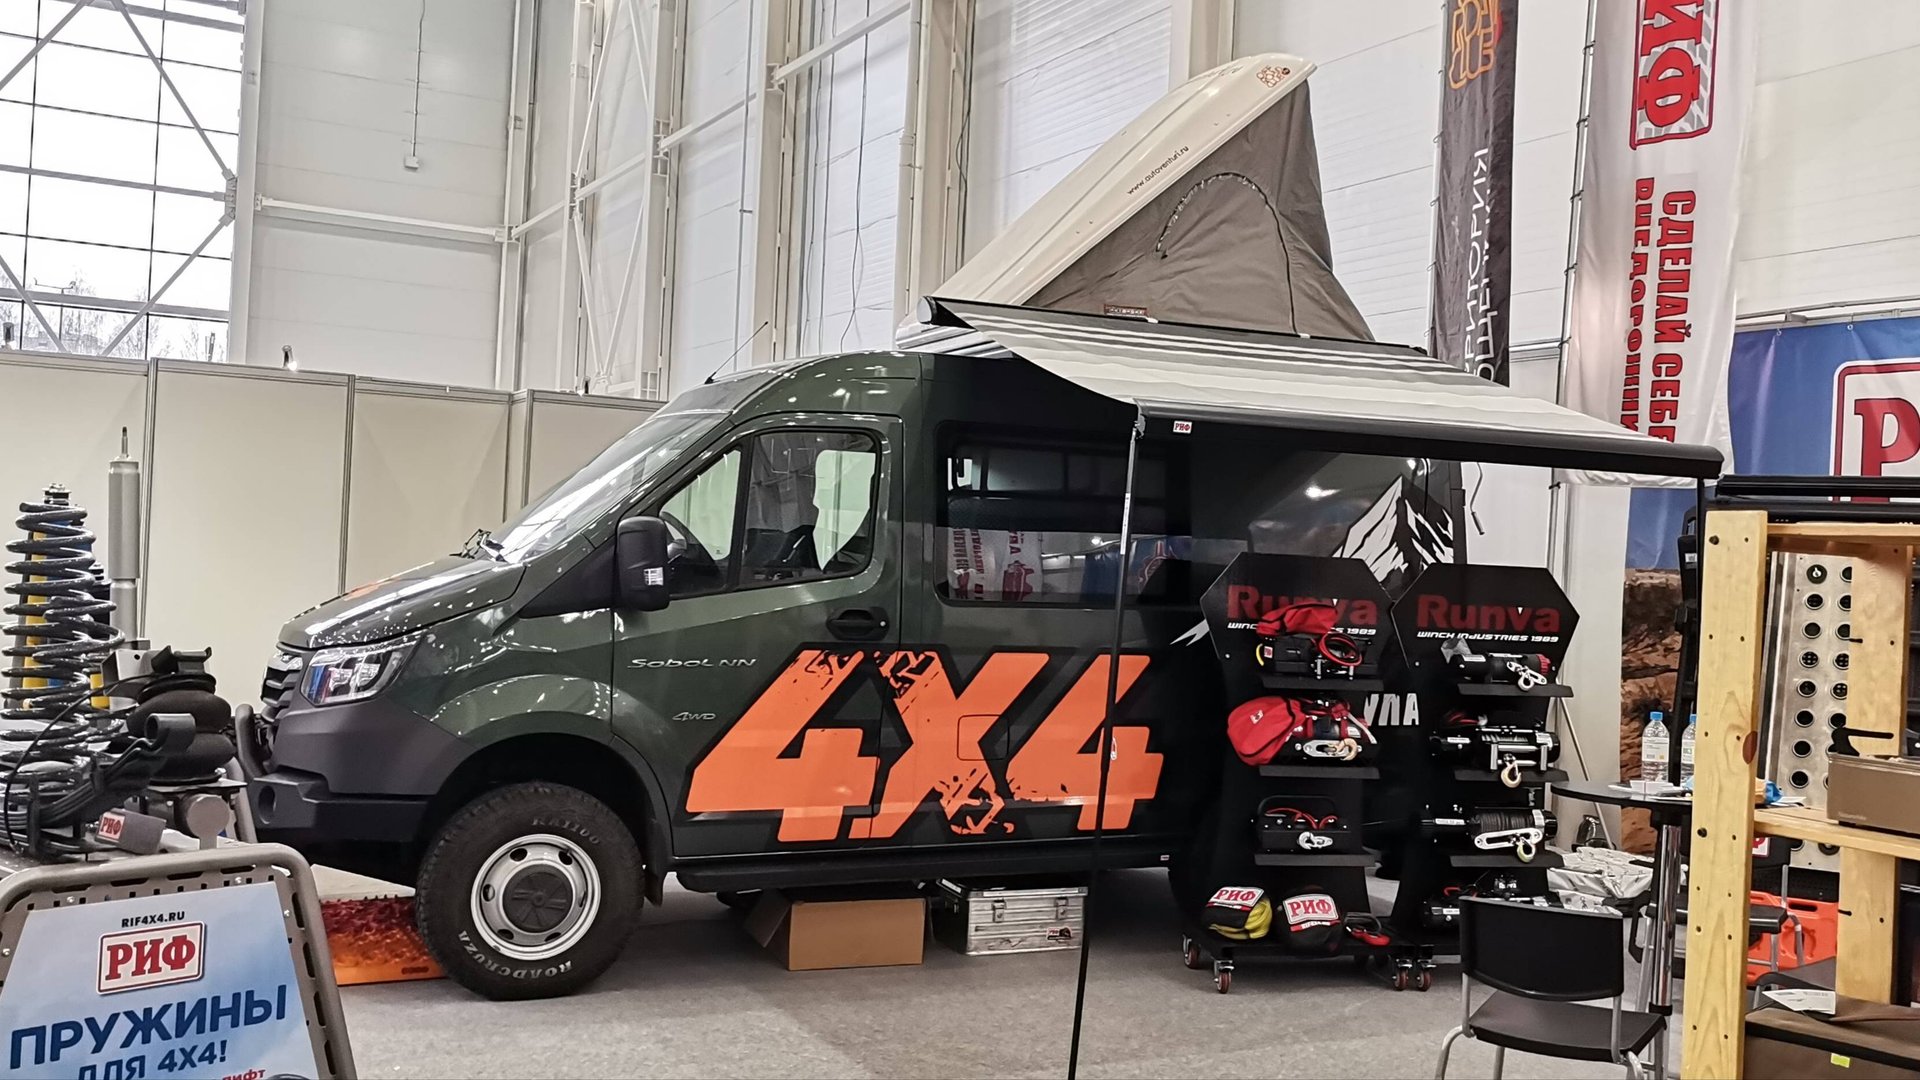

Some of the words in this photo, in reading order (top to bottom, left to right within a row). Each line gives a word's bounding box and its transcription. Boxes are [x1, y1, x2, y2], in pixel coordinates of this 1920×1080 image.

[1127, 146, 1189, 194] www.autoventuri.ru
[1462, 148, 1488, 373] РИТОРИЯ
[1654, 190, 1697, 343] СДЕЛАЙ
[1227, 584, 1378, 625] Rva
[1417, 594, 1560, 633] Runva
[1227, 622, 1257, 630] WINC
[1417, 631, 1455, 639] WINCH
[719, 658, 757, 667] NN
[686, 650, 1164, 842] 4X4
[101, 816, 122, 835] РИФ
[1214, 889, 1257, 902] РИФ
[1288, 899, 1333, 917] РИФ
[121, 911, 185, 928] RIF4X4.RU
[105, 934, 196, 981] РИФ
[10, 985, 287, 1069] ПРУЖИНЫ
